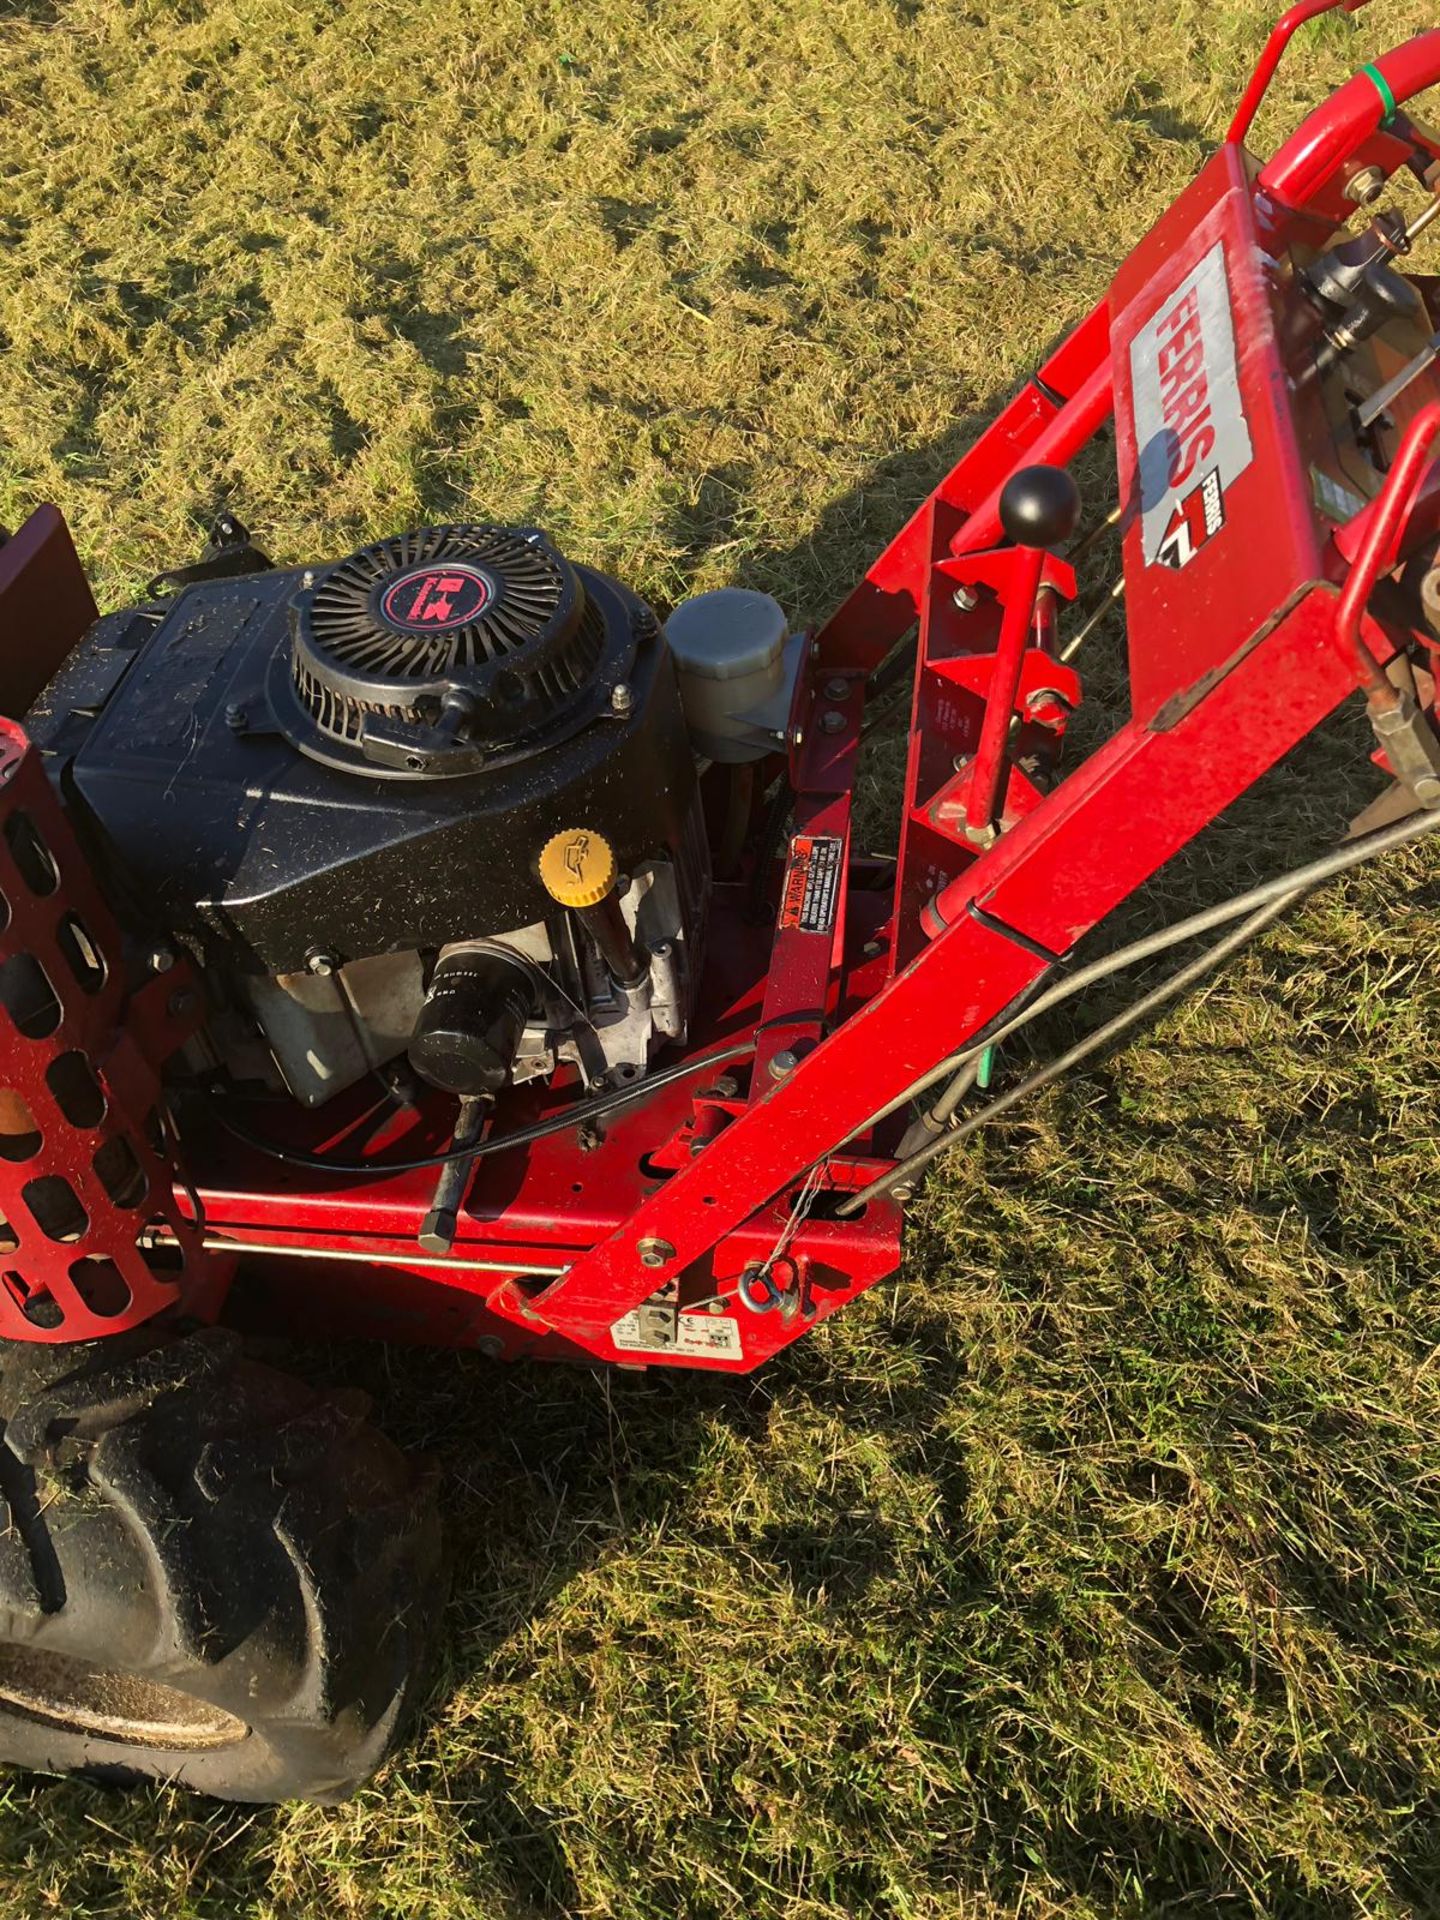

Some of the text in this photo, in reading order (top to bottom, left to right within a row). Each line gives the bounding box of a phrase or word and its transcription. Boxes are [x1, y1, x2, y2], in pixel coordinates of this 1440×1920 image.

[1156, 286, 1216, 488] FERRIS
[1202, 471, 1222, 536] FERRIS
[789, 850, 807, 903] WARNIG
